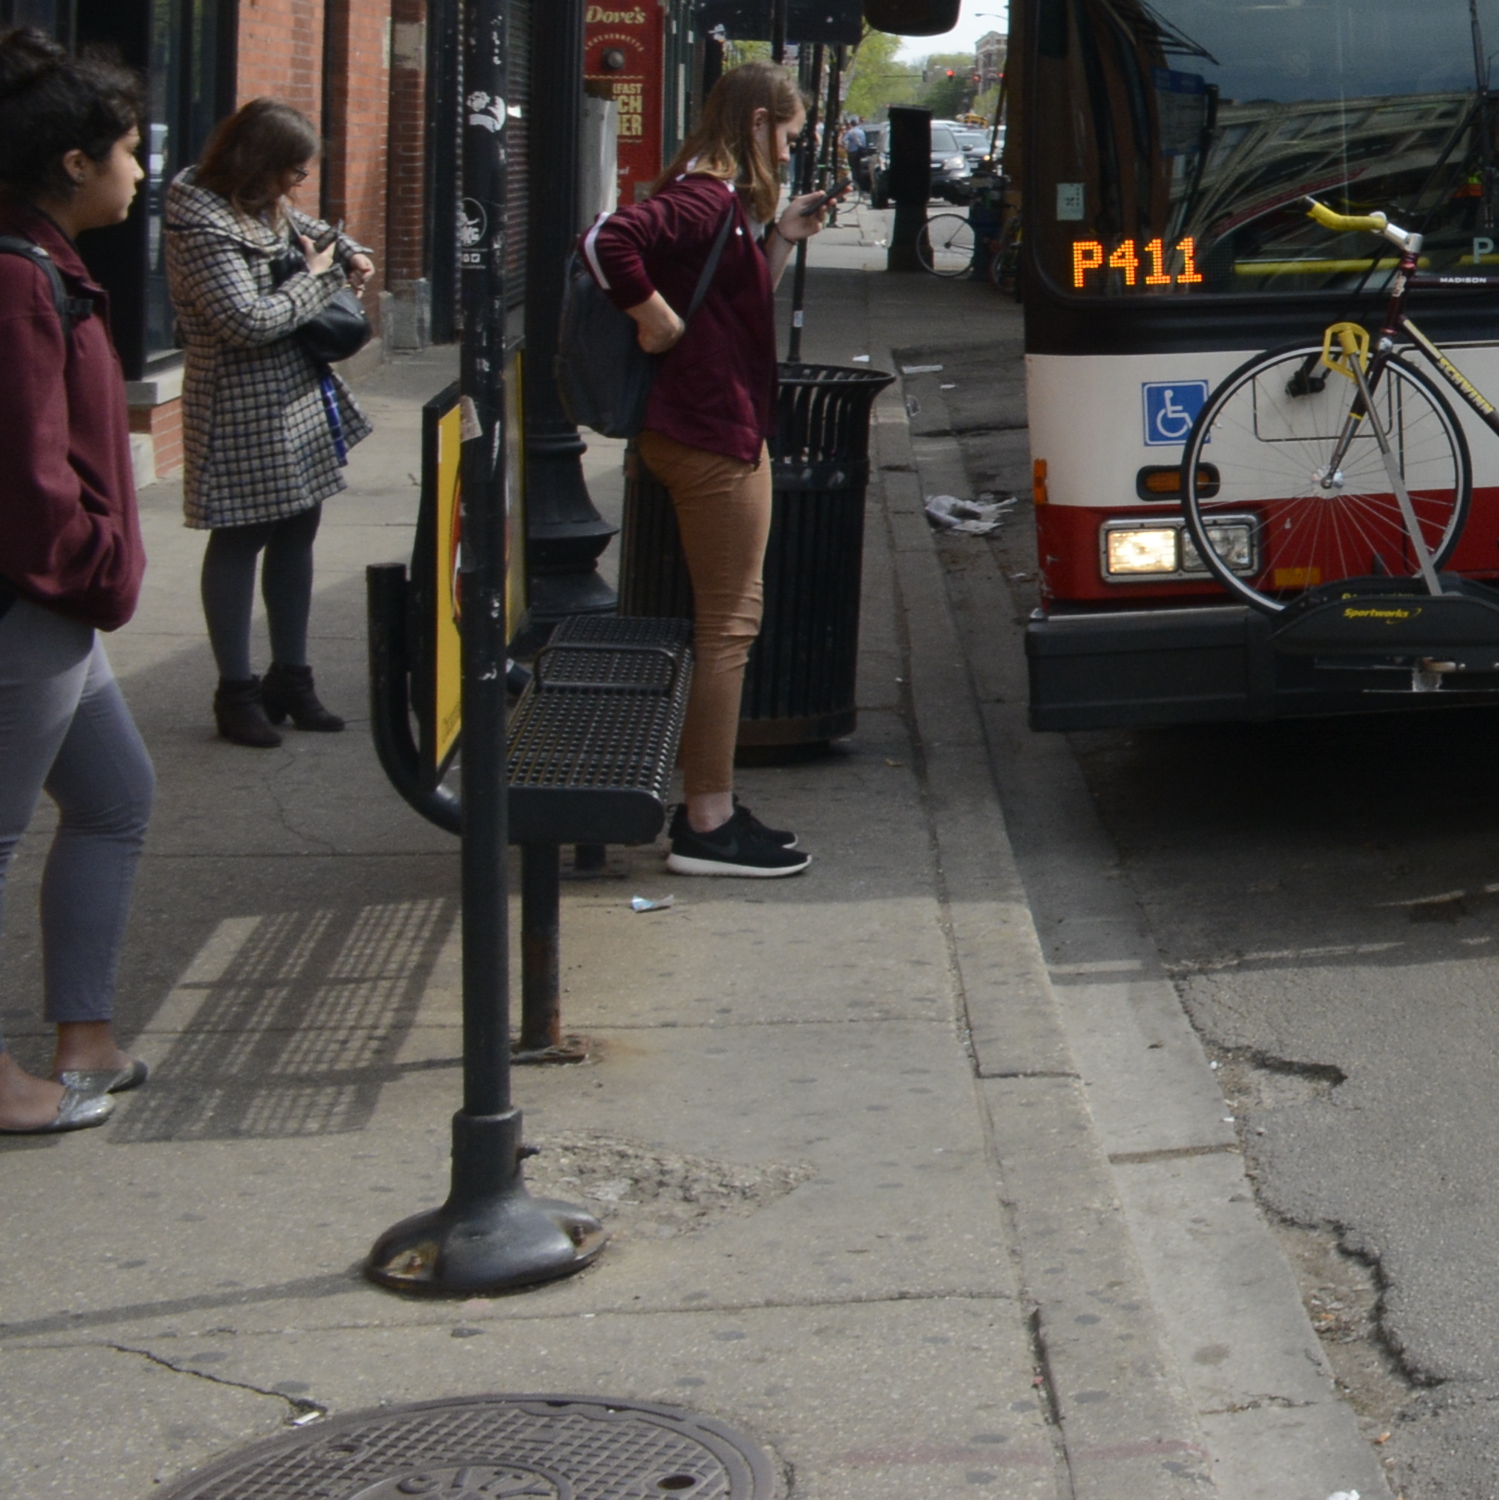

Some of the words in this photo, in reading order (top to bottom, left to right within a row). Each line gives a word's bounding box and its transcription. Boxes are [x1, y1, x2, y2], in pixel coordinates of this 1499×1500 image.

[585, 5, 646, 24] Dove's
[1072, 237, 1203, 288] P411
[1473, 237, 1494, 264] P
[1440, 276, 1487, 284] MADISON
[1437, 356, 1495, 414] SCHWINN
[1343, 607, 1410, 619] Sportworks
[396, 1467, 551, 1497] CITY
